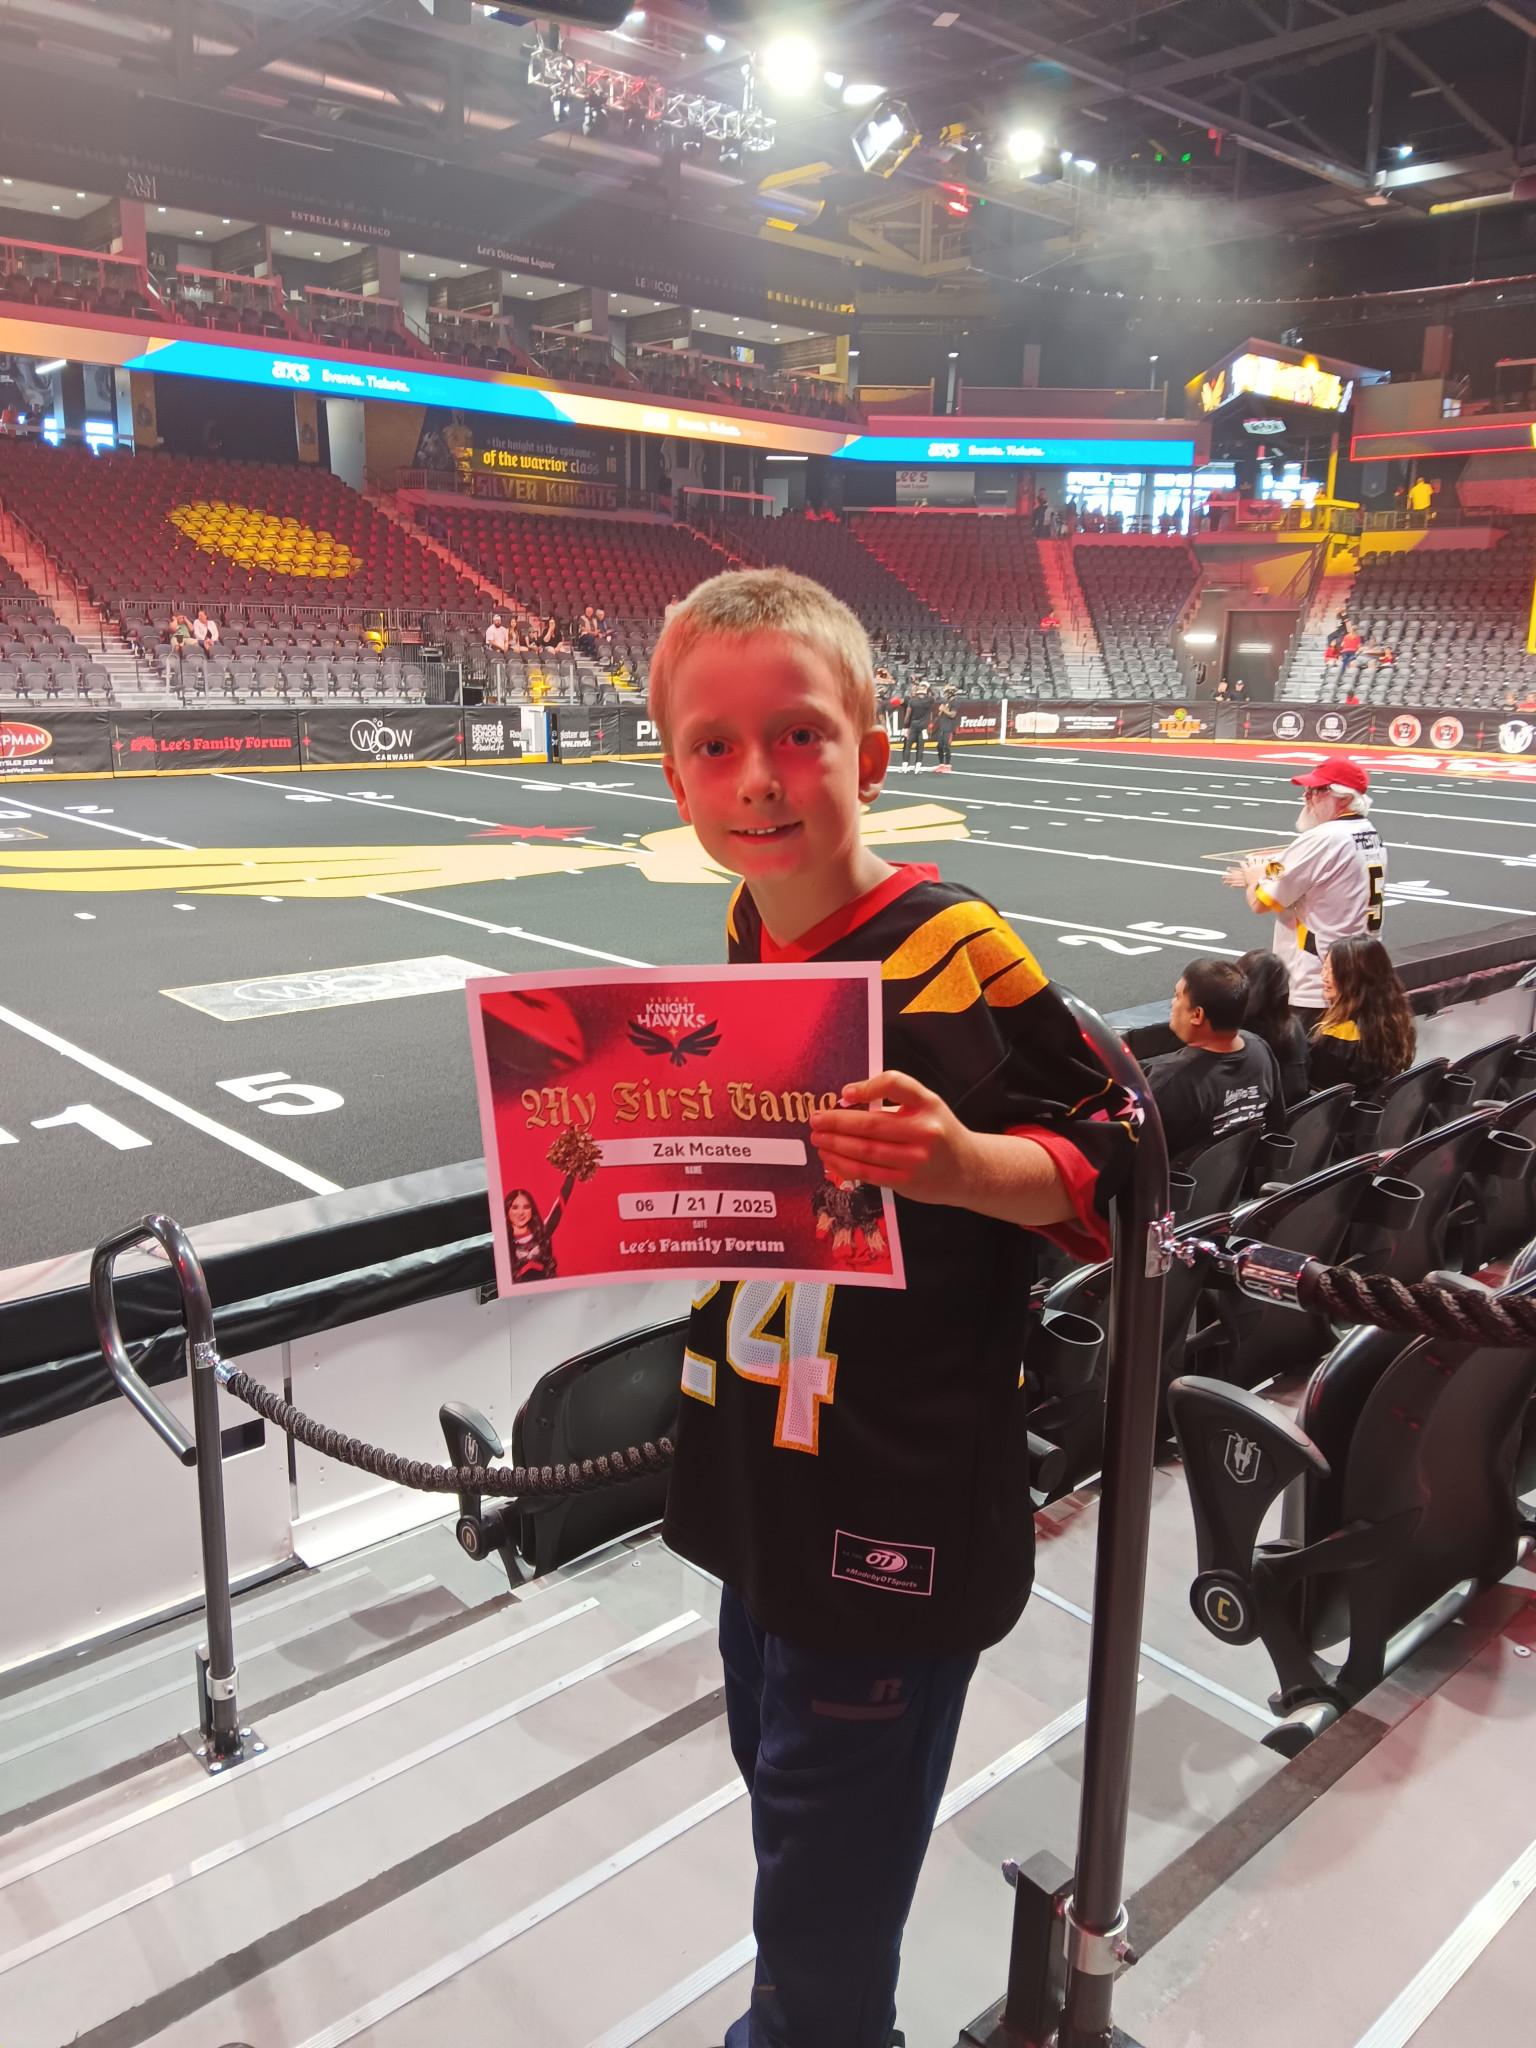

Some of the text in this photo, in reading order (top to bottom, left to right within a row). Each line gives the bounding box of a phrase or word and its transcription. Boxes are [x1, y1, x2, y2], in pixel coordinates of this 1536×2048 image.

[128, 171, 156, 188] SAM
[134, 184, 157, 199] ASH
[291, 210, 391, 237] ESTRELLA JALISCO
[477, 245, 556, 270] Lee's Discount Liquor
[322, 368, 365, 387] Events.
[366, 374, 411, 393] Tickets.
[507, 439, 535, 453] knight
[483, 449, 600, 475] of the warrior class
[476, 473, 617, 508] SILVER KNIGHTS
[471, 724, 498, 732] NEVADA
[959, 716, 997, 728] Freedom
[1159, 720, 1201, 732] TEXAS
[0, 733, 46, 746] PMAN
[356, 726, 414, 751] WOW
[471, 730, 498, 738] DONOR
[472, 736, 505, 745] NETWORK
[160, 736, 292, 753] Lee's Family Forum
[375, 753, 415, 761] CARWASH
[645, 1002, 696, 1014] KNIGHT
[637, 1013, 707, 1028] HAWKS
[521, 1078, 838, 1132] My First Game
[653, 1142, 752, 1157] Zak Mcatee
[684, 1165, 704, 1175] NAME
[635, 1199, 655, 1212] 06
[686, 1197, 706, 1211] 21
[732, 1199, 774, 1213] 2025
[692, 1219, 708, 1230] DATE
[619, 1236, 785, 1255] Lee's Family Forum
[865, 1552, 897, 1567] OT
[846, 1567, 918, 1588] #MadebyOTSports
